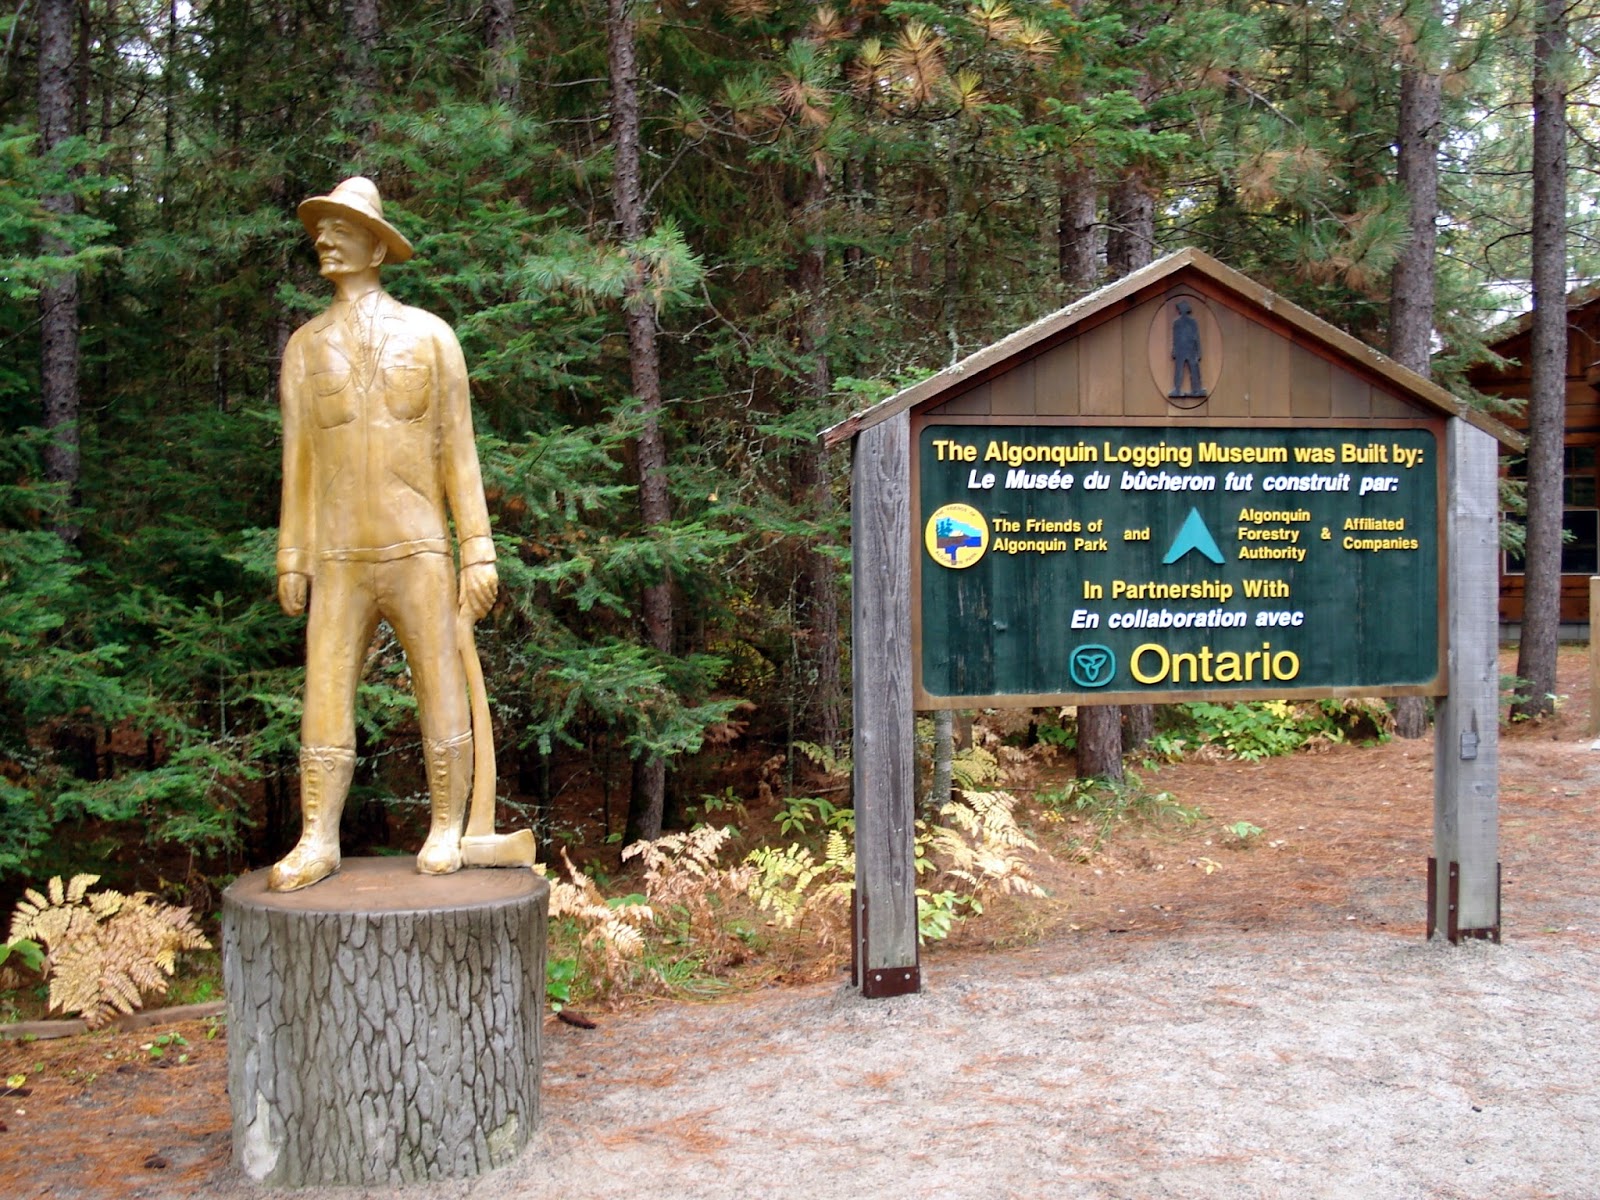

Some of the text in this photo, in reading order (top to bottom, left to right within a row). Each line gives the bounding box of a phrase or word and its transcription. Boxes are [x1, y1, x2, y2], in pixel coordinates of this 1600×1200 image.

[933, 441, 1424, 469] The Algonquin Logging Museum was Built by:
[968, 469, 1399, 496] Le Musée du bûcheron fut construit par:
[1239, 508, 1311, 525] Algonquin
[1344, 518, 1405, 531] Affiliated
[992, 518, 1103, 533] The Friends of
[1124, 527, 1150, 541] and
[1320, 527, 1332, 540] &
[1238, 527, 1300, 543] Forestry
[992, 537, 1108, 555] Algonquin Park
[1343, 535, 1419, 553] Companies
[1239, 546, 1306, 562] Authority
[1084, 580, 1290, 603] In Partnership With
[1071, 608, 1304, 629] En collaboration avec
[1130, 642, 1300, 684] Ontario
